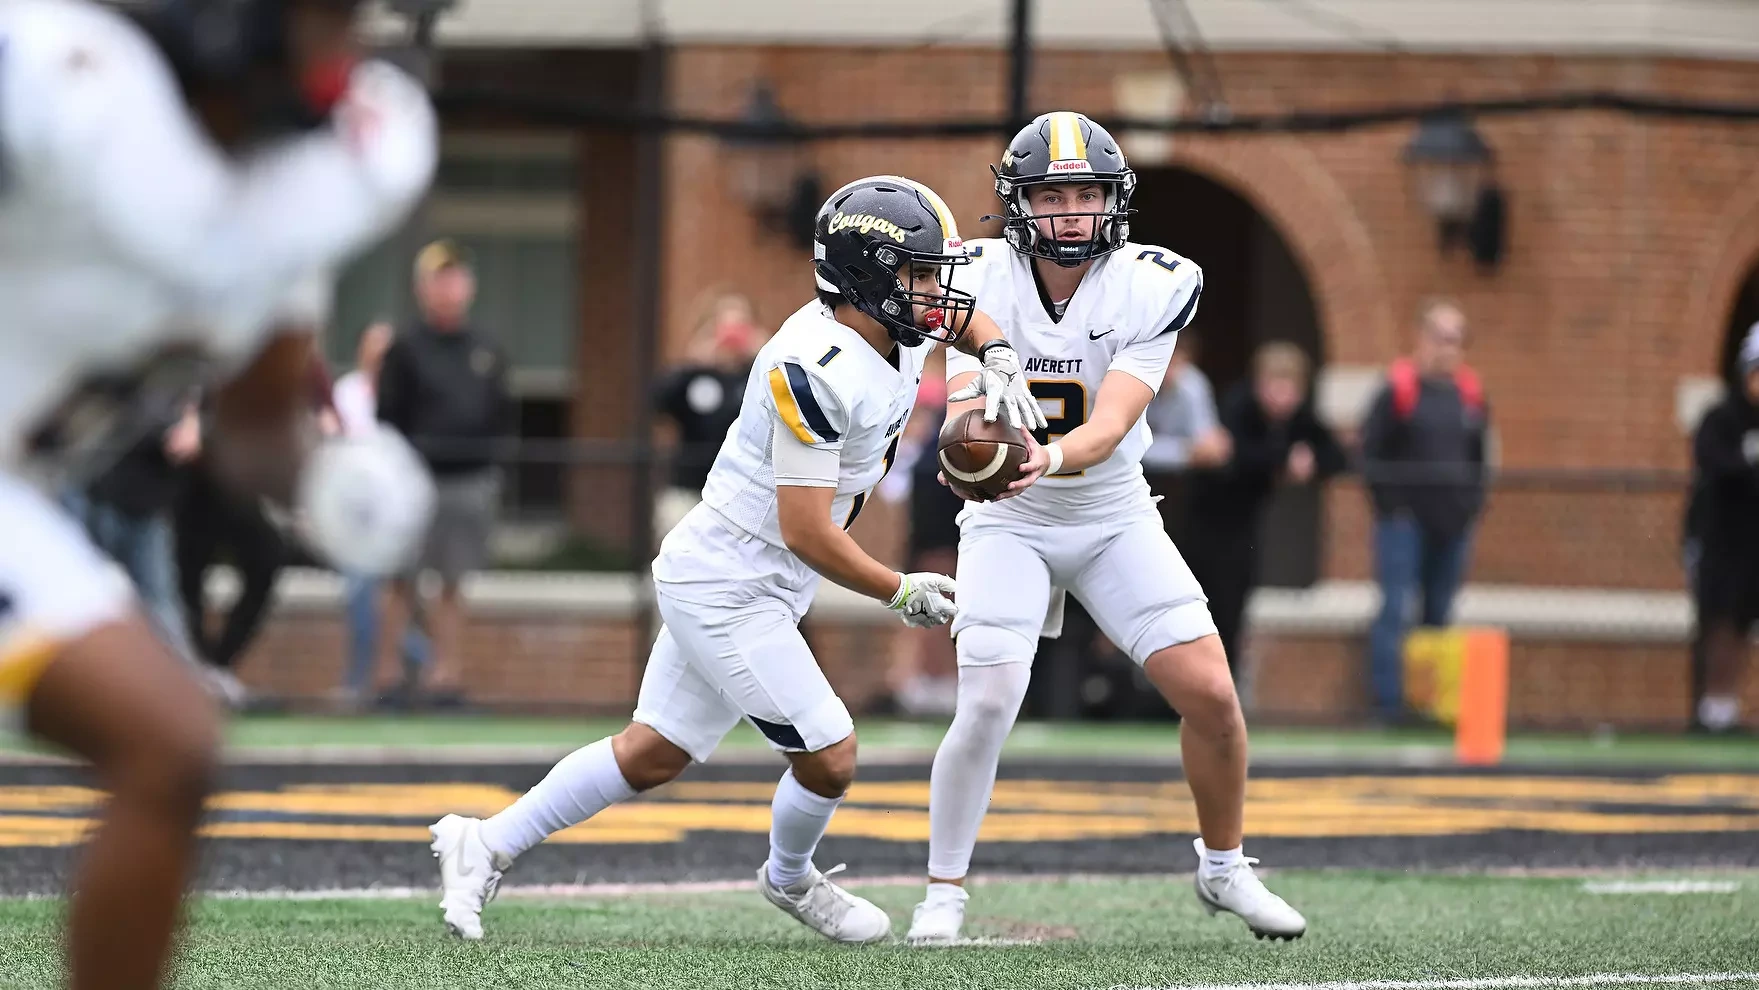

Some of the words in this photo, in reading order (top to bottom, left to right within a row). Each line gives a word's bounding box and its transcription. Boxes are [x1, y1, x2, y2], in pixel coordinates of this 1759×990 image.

[1052, 162, 1087, 171] Riddell
[828, 211, 905, 243] Cougars
[1135, 250, 1181, 273] 2
[816, 346, 842, 368] 1
[1025, 357, 1083, 374] AVERETT
